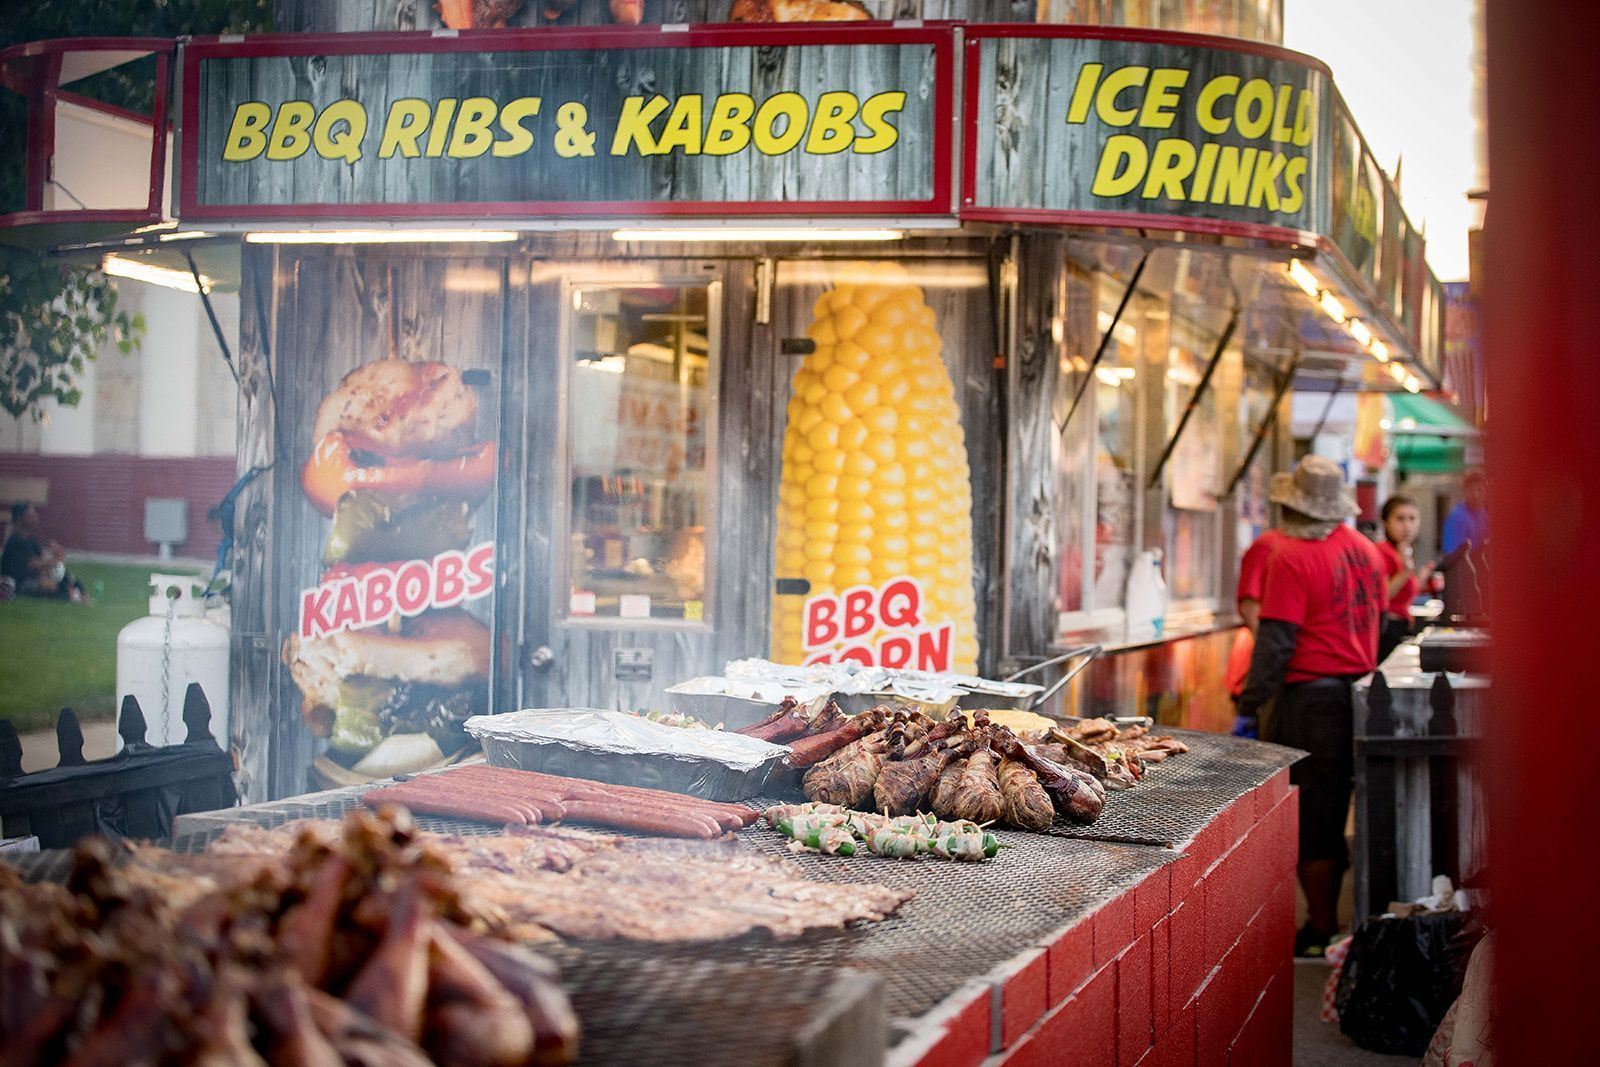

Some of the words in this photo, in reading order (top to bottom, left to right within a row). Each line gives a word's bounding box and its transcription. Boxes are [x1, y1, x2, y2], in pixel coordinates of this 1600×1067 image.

[222, 100, 367, 165] BBQ
[377, 97, 542, 159] RIBS
[553, 101, 596, 158] &
[610, 91, 906, 157] KABOBS
[1066, 62, 1191, 129] ICE
[1195, 75, 1316, 148] COLD
[1091, 135, 1308, 213] DRINKS
[299, 541, 496, 641] KABOBS
[804, 578, 921, 649] BBQ
[805, 625, 953, 673] RN
